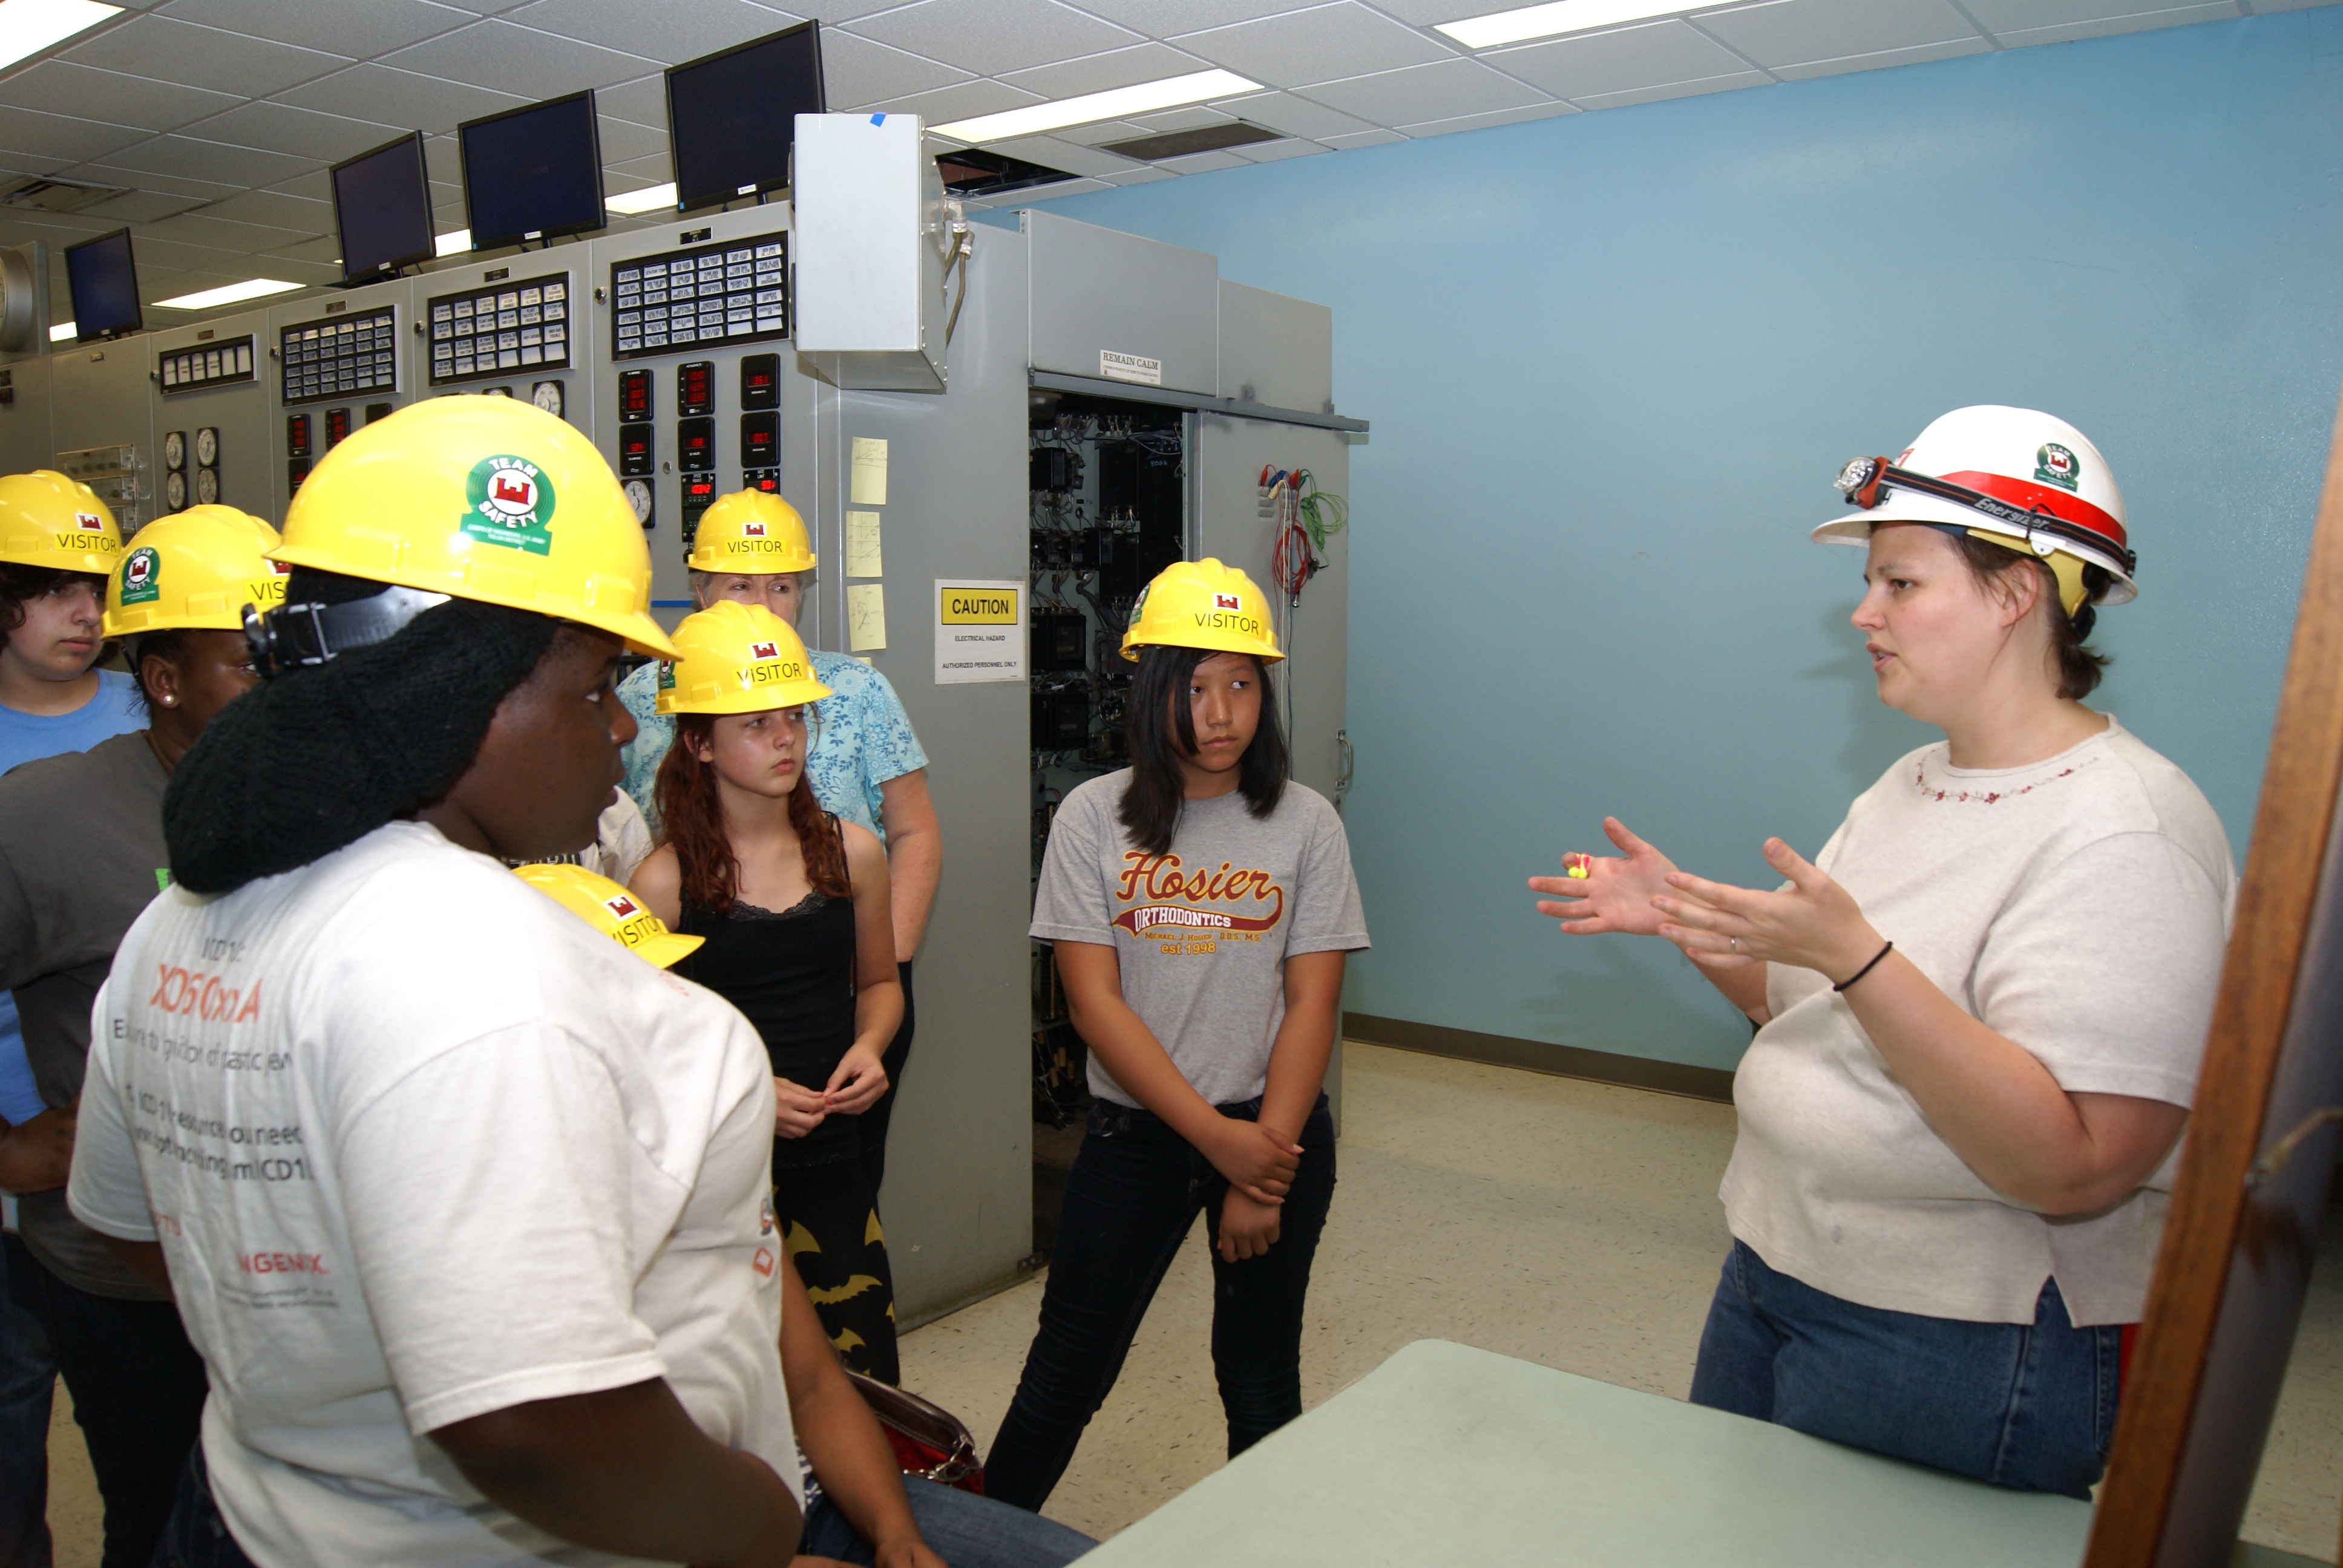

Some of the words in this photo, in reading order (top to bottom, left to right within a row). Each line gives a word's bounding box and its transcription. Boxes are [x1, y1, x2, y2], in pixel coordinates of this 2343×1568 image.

[1103, 352, 1135, 365] REMAIN
[1137, 359, 1158, 370] CALM
[488, 457, 539, 478] TEAM
[478, 500, 538, 528] SAFETY
[1974, 498, 2050, 529] Energizer
[57, 534, 117, 553] VISITOR
[727, 540, 782, 553] VISITOR
[250, 581, 287, 601] VIS
[952, 599, 1009, 614] CAUTION
[1195, 613, 1259, 635] VISITOR
[736, 663, 802, 683] VISITOR
[1116, 850, 1283, 903] Hosier
[1133, 907, 1231, 932] ORTHODONTICS
[612, 916, 658, 947] ISITO
[1161, 942, 1181, 955] est
[1185, 942, 1216, 955] 1998
